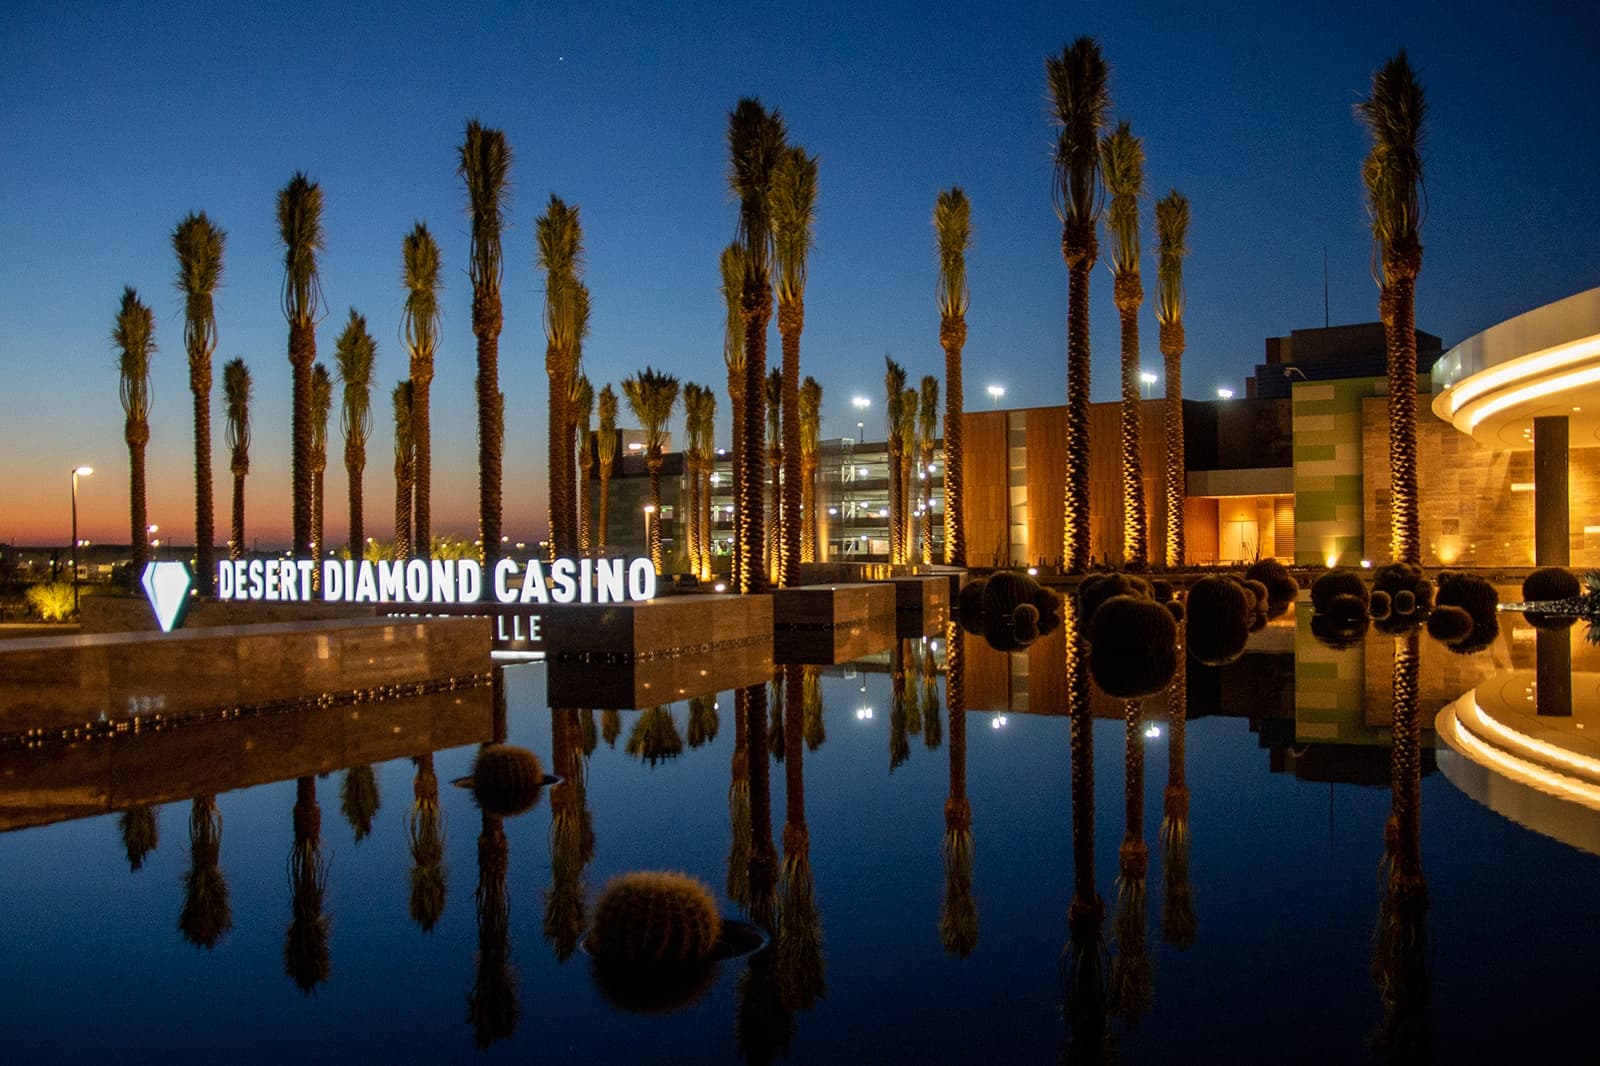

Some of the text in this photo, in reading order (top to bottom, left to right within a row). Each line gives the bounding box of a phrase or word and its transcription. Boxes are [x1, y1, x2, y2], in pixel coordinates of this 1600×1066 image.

[218, 556, 657, 604] DESERT DIAMOND CASINO
